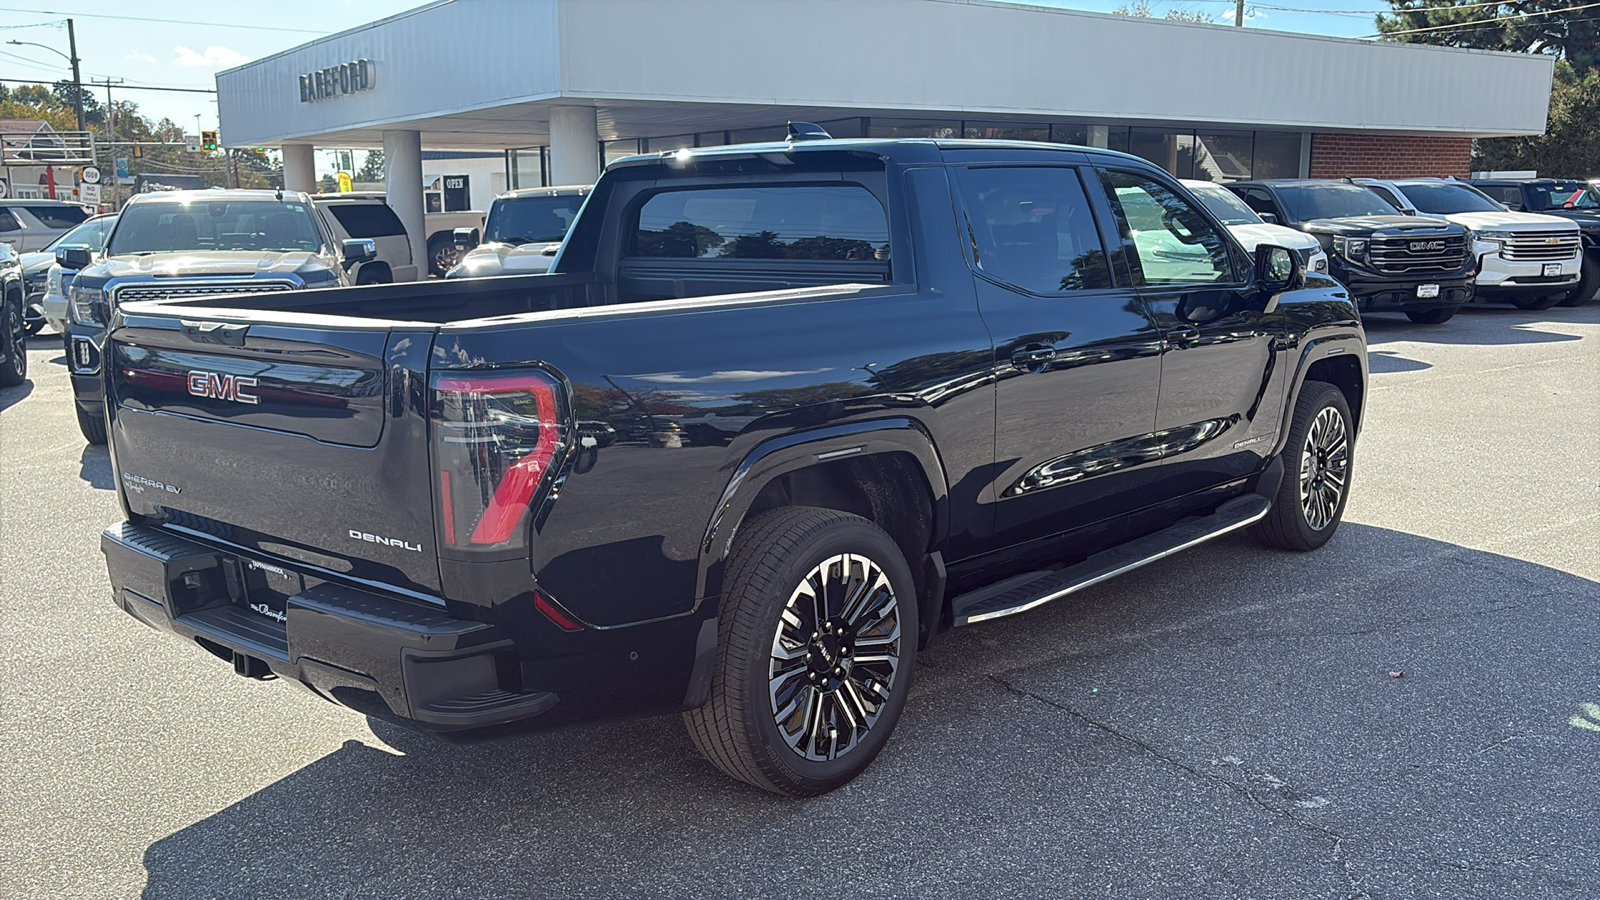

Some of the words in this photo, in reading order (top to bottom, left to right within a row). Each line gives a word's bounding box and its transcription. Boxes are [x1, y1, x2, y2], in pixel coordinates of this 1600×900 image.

[299, 58, 376, 103] BAREFORD
[446, 178, 464, 189] OPEN
[1410, 240, 1445, 250] GMC
[187, 370, 260, 404] GMC
[1233, 437, 1261, 450] DENALI
[123, 472, 165, 490] SIERRA
[166, 484, 182, 495] EV
[349, 529, 422, 552] DENALI
